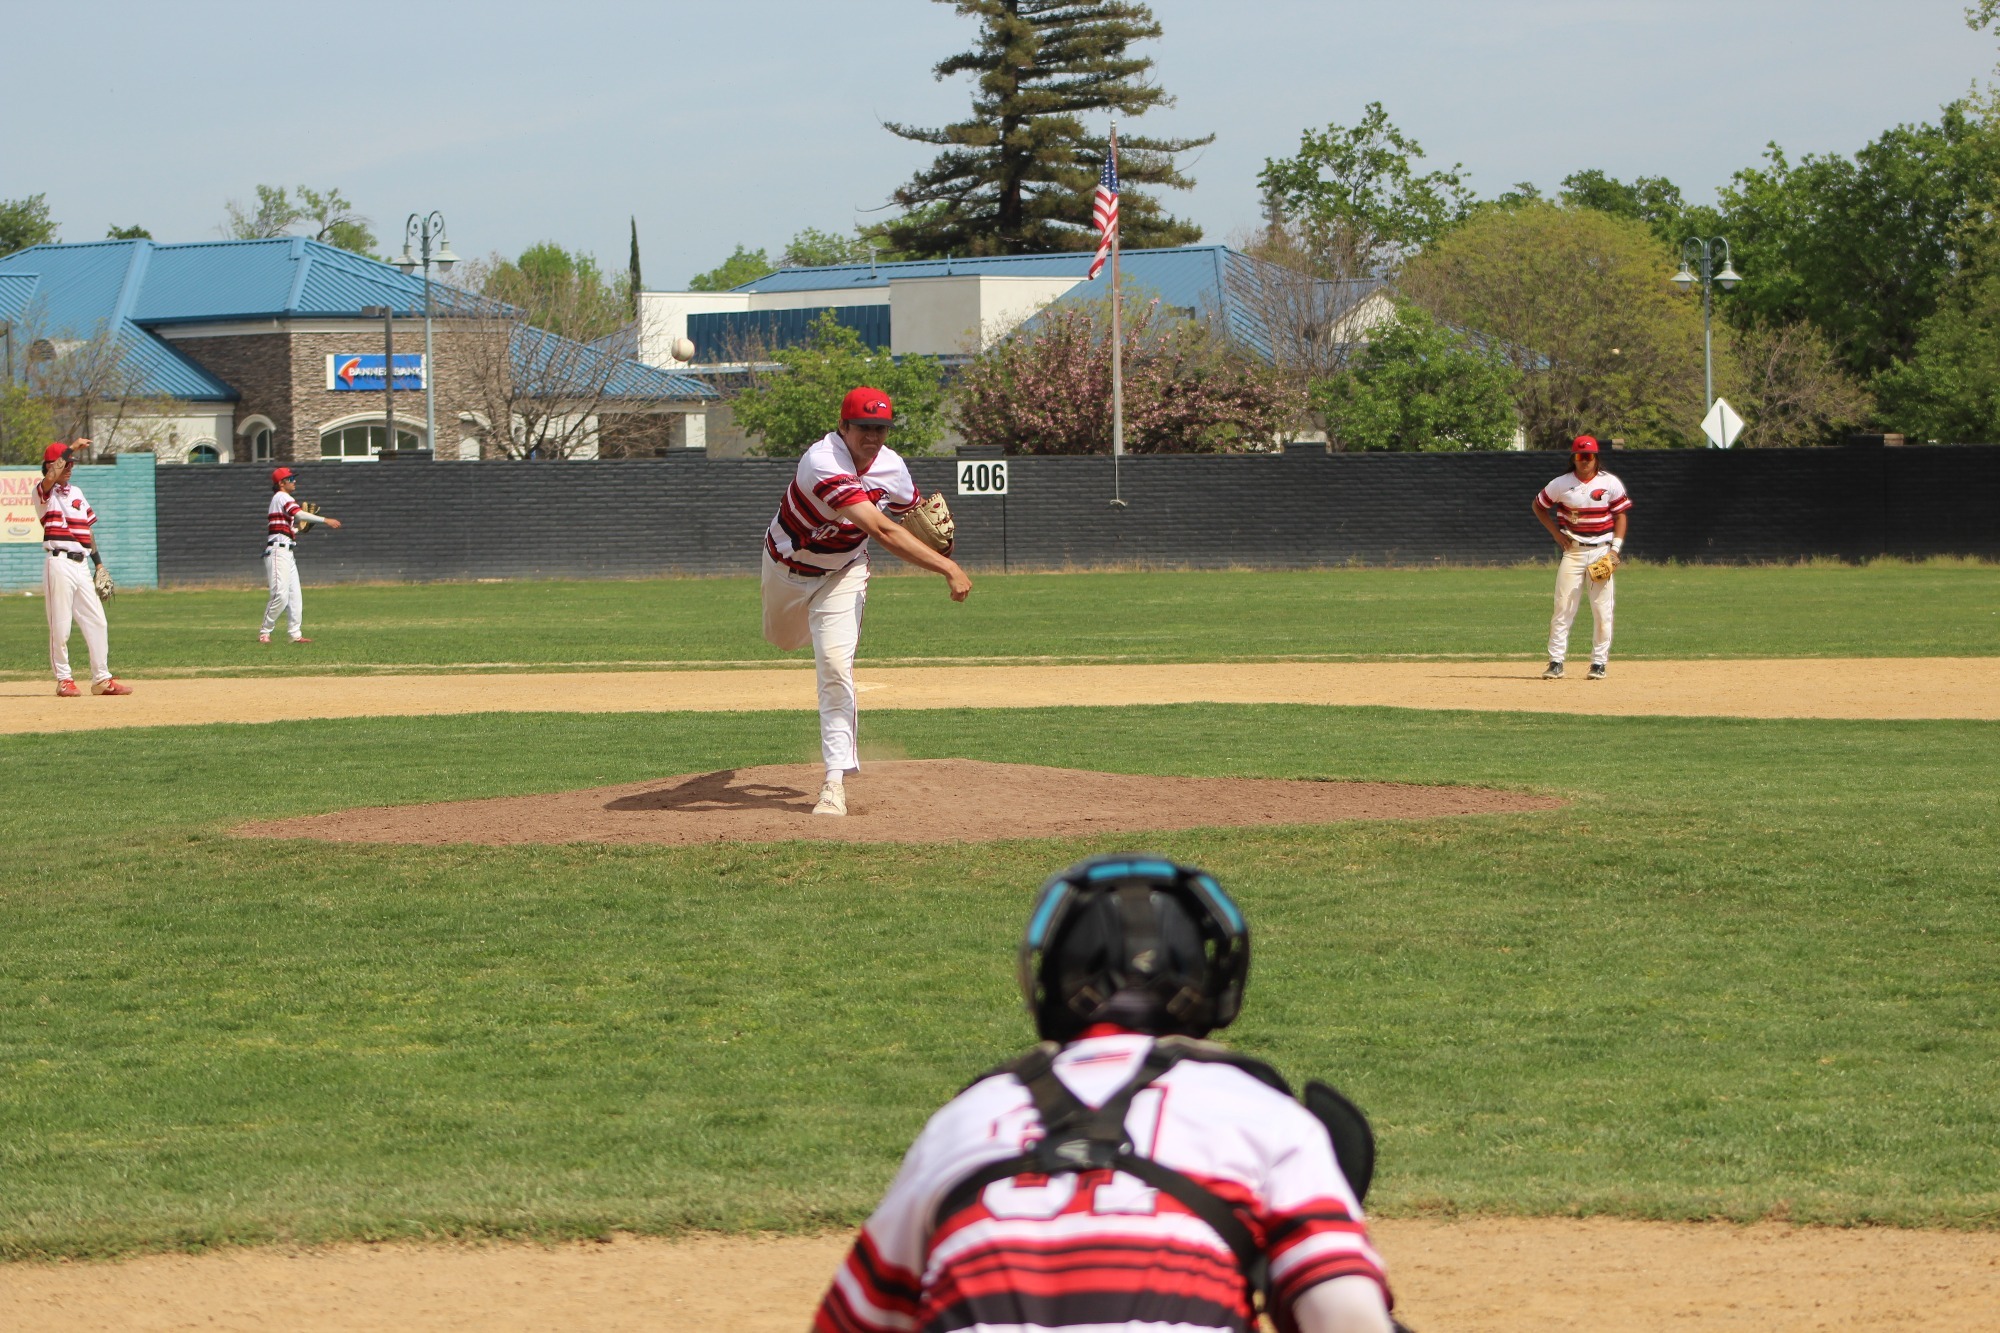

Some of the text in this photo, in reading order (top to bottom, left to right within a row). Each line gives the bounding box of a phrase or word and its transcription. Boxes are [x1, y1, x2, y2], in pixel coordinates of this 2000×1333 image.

[348, 367, 422, 377] BANNE BANK
[0, 476, 44, 495] NA'
[961, 464, 1005, 491] 406
